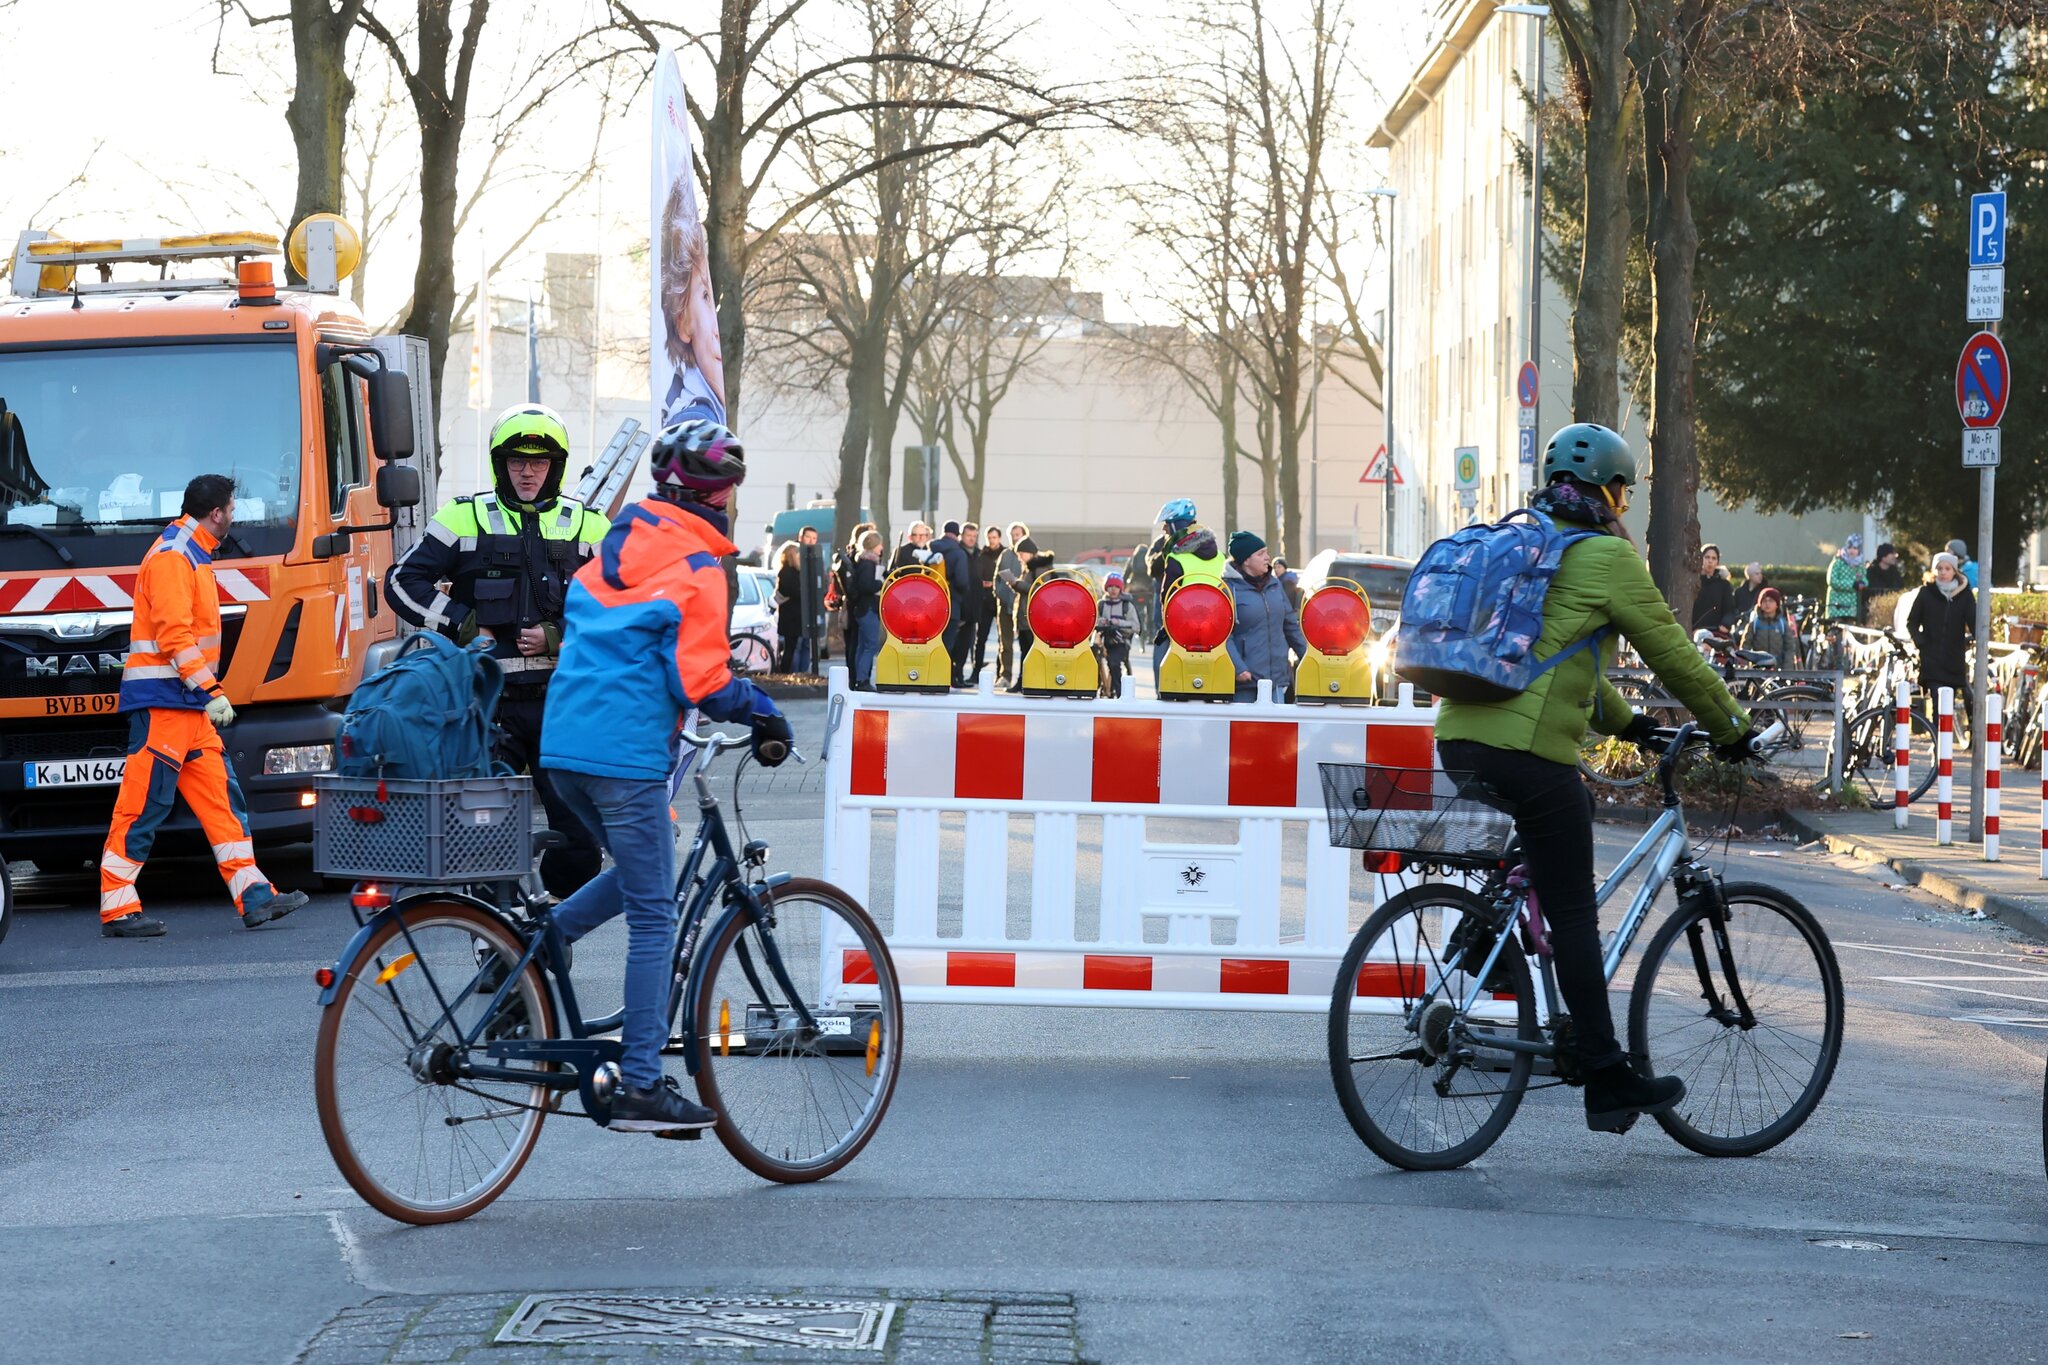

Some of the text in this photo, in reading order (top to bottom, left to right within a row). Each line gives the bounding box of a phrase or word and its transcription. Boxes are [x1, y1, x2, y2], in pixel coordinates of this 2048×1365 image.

[1977, 203, 1997, 257] P
[1521, 433, 1531, 460] P
[1971, 433, 1981, 444] Mo
[1985, 432, 1992, 444] Fr
[1463, 459, 1472, 477] H
[546, 527, 572, 536] POLIZEI
[25, 653, 128, 677] MAN
[45, 695, 116, 714] BVB 09
[37, 766, 50, 784] K
[63, 763, 90, 783] LN
